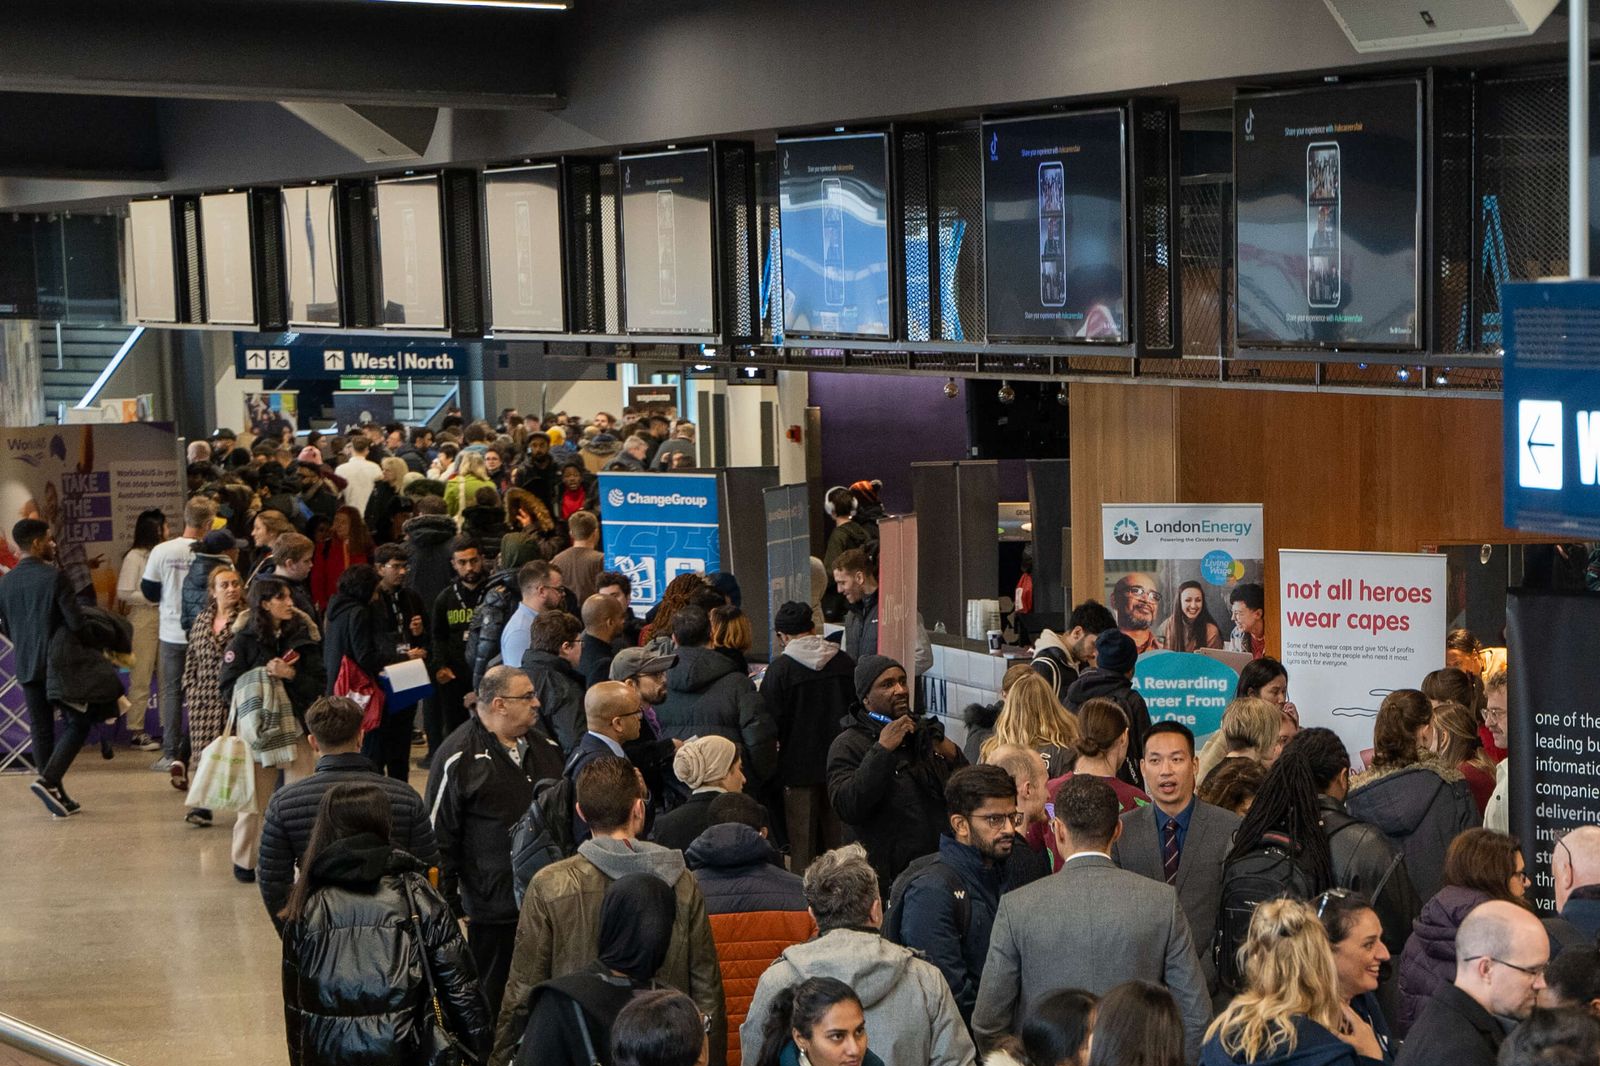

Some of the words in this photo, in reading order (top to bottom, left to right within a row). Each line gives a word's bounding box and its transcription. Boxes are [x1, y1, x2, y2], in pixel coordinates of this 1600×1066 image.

[351, 352, 396, 370] West
[404, 352, 454, 370] North
[63, 474, 98, 493] TAKE
[64, 498, 94, 517] THE
[627, 492, 708, 508] ChangeGroup
[66, 523, 100, 542] LEAP
[1146, 520, 1252, 537] LondonEnergy
[1204, 558, 1230, 569] Living
[1209, 565, 1233, 577] Wage
[1287, 579, 1321, 600] not
[1327, 578, 1352, 601] all
[1360, 578, 1432, 604] heroes
[1286, 611, 1341, 628] wear
[1346, 613, 1410, 636] capes
[1339, 644, 1352, 652] caps
[1365, 645, 1376, 653] give
[1397, 646, 1415, 654] profits
[1131, 677, 1140, 689] A
[1145, 676, 1227, 692] Rewarding
[1186, 695, 1226, 708] From
[1535, 712, 1560, 727] one
[1563, 711, 1577, 727] of
[1535, 732, 1583, 755] leading
